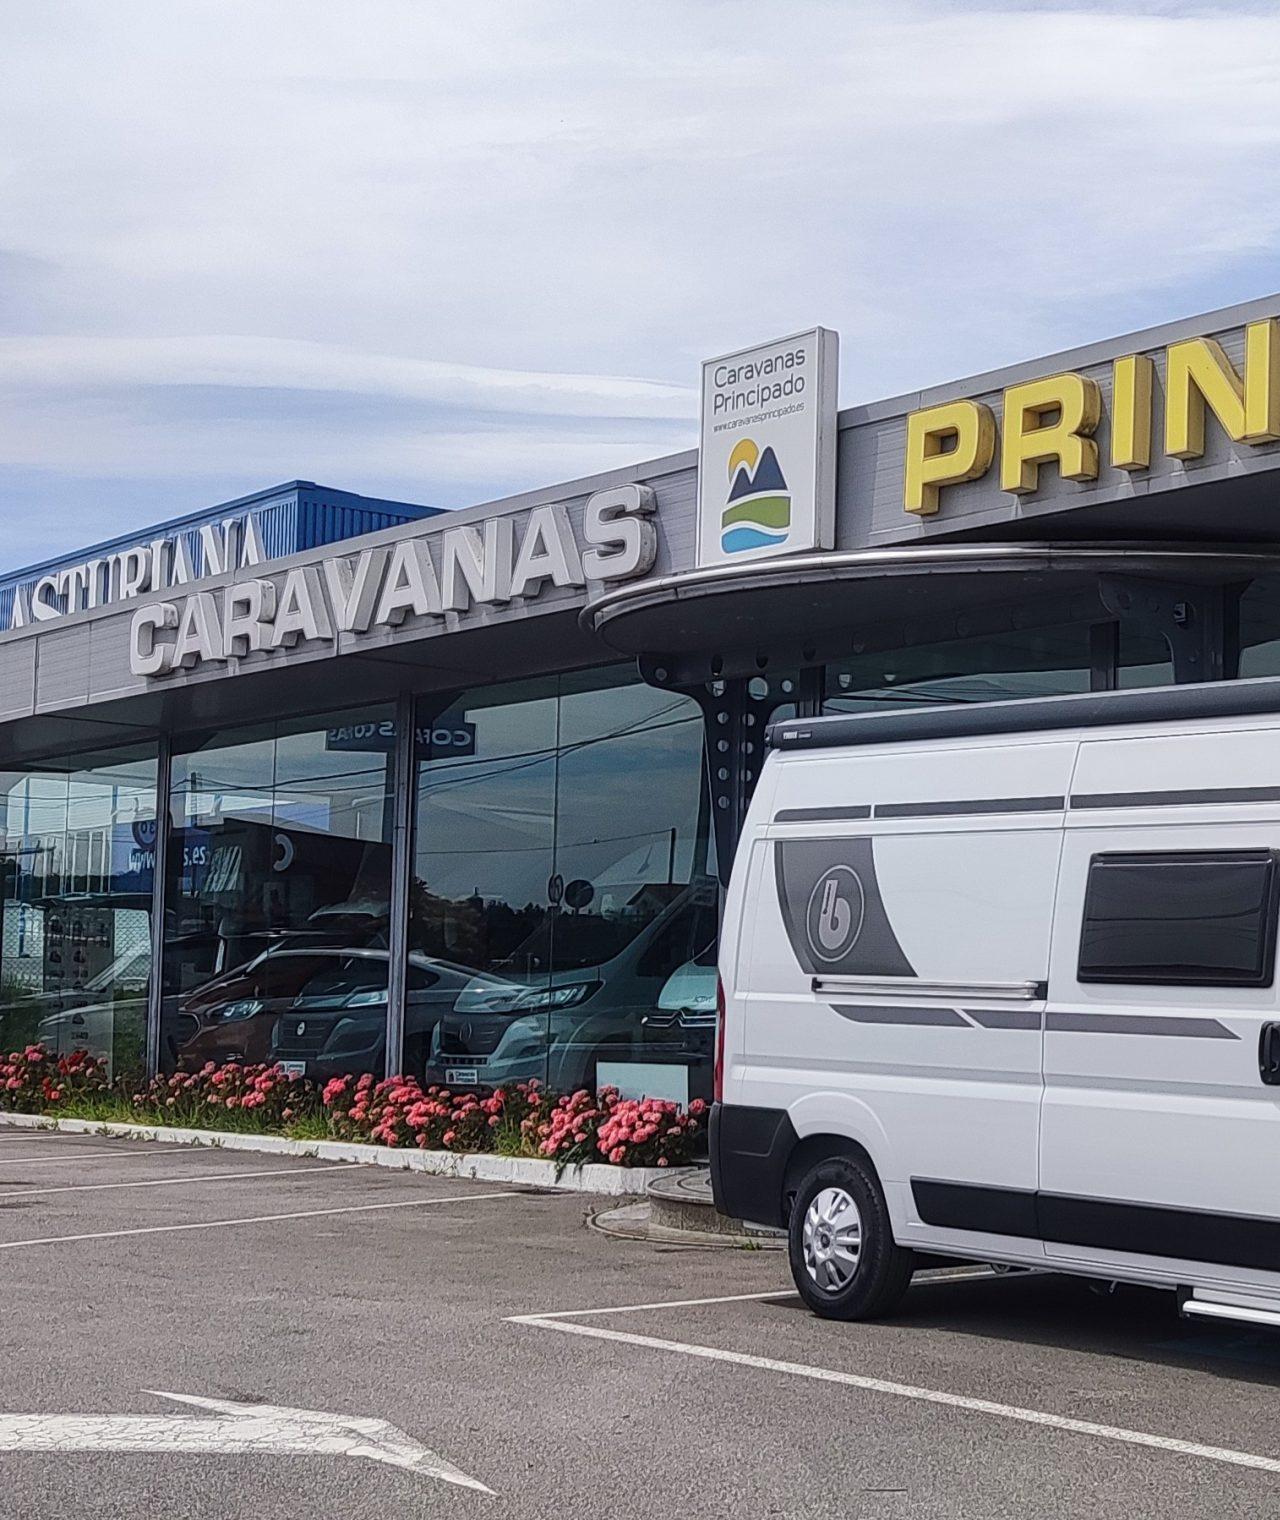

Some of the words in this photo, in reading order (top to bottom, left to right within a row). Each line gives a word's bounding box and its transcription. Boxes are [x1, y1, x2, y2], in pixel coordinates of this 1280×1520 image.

[714, 349, 806, 388] Caravanas
[713, 373, 805, 415] Principado
[129, 482, 658, 678] CARAVANAS
